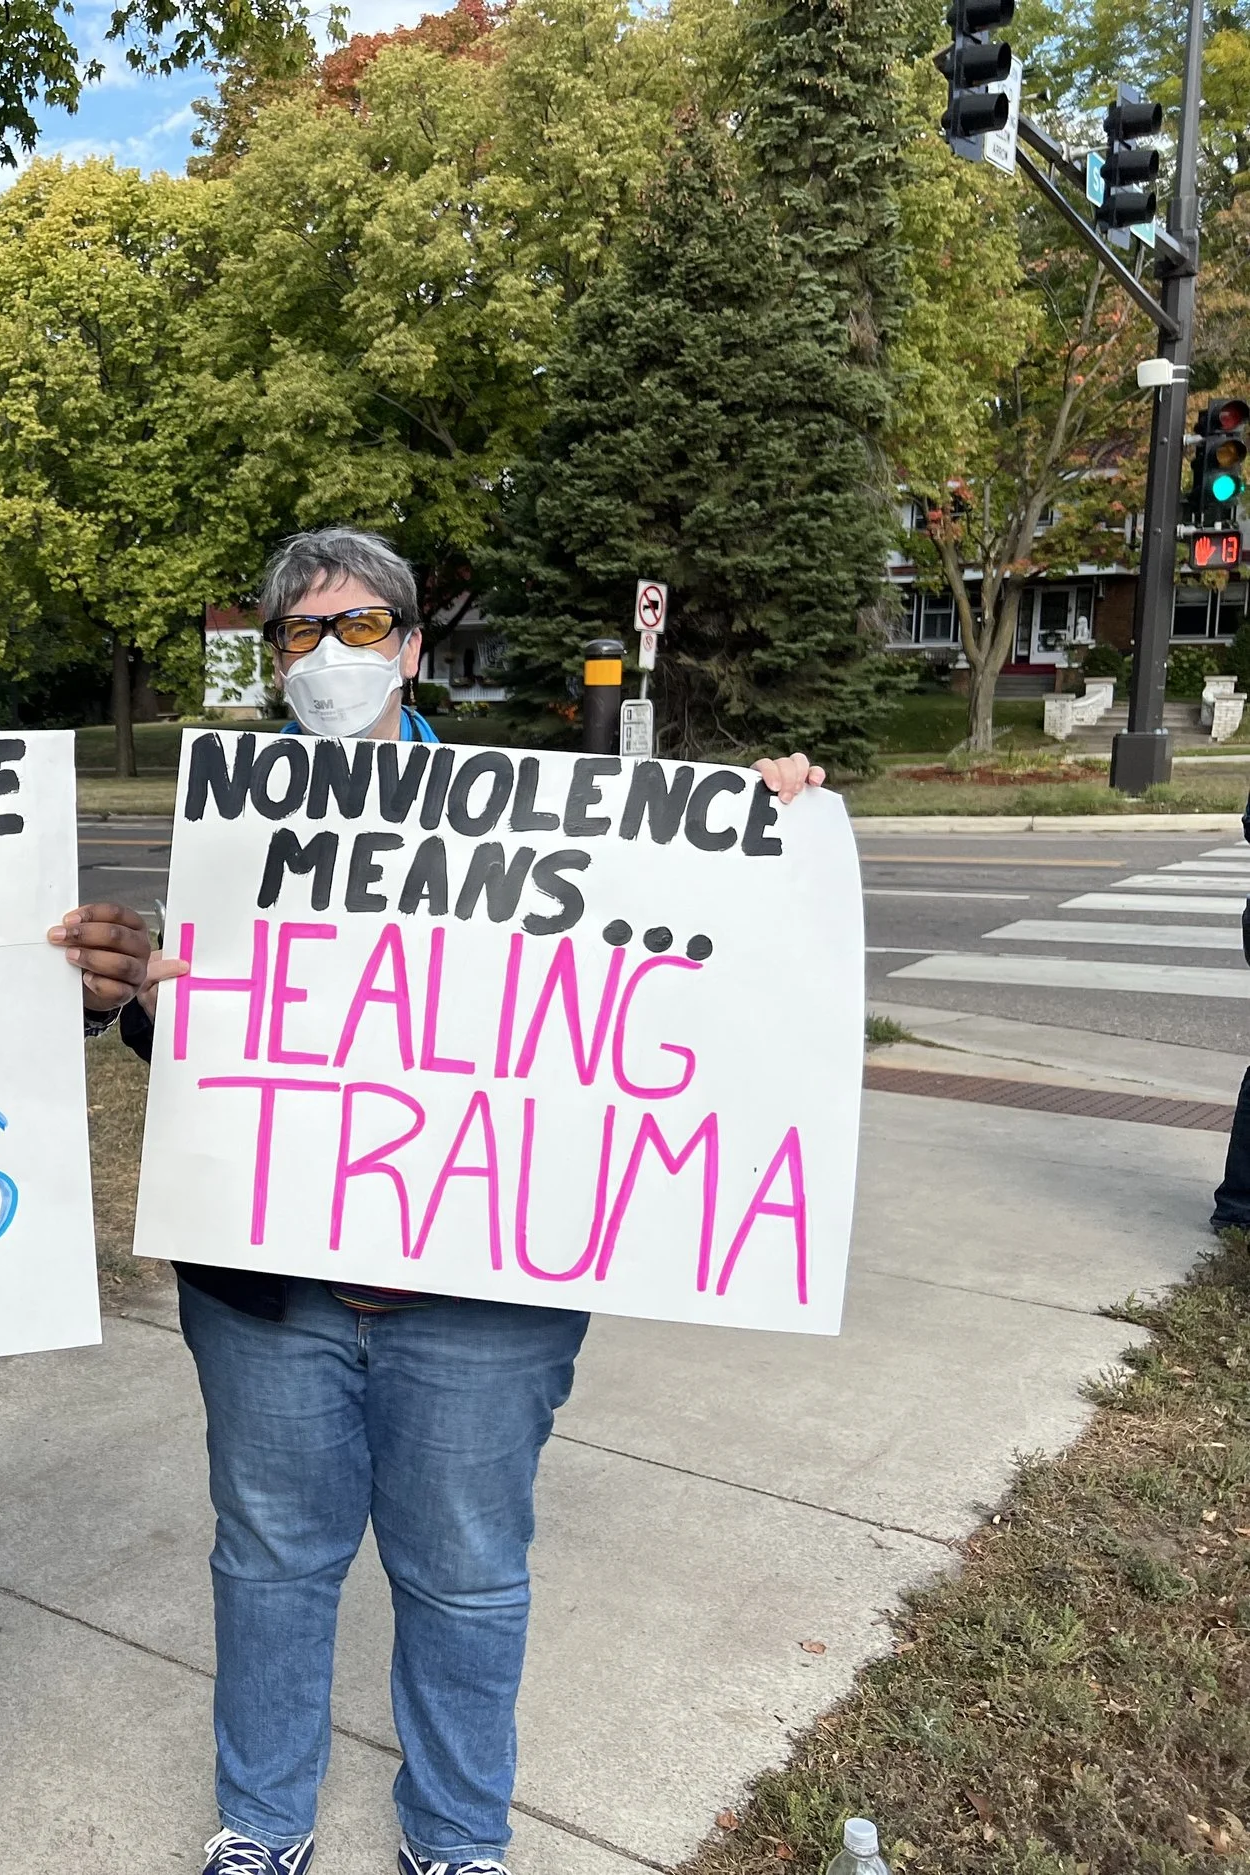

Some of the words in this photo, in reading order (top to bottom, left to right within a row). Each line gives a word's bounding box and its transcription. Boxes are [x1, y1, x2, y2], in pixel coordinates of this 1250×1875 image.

[1222, 536, 1238, 563] 13
[313, 699, 334, 710] 3M
[184, 732, 783, 857] NONVIOLENCE
[173, 919, 704, 1101] HEALING
[197, 1076, 809, 1306] TRAUMA
